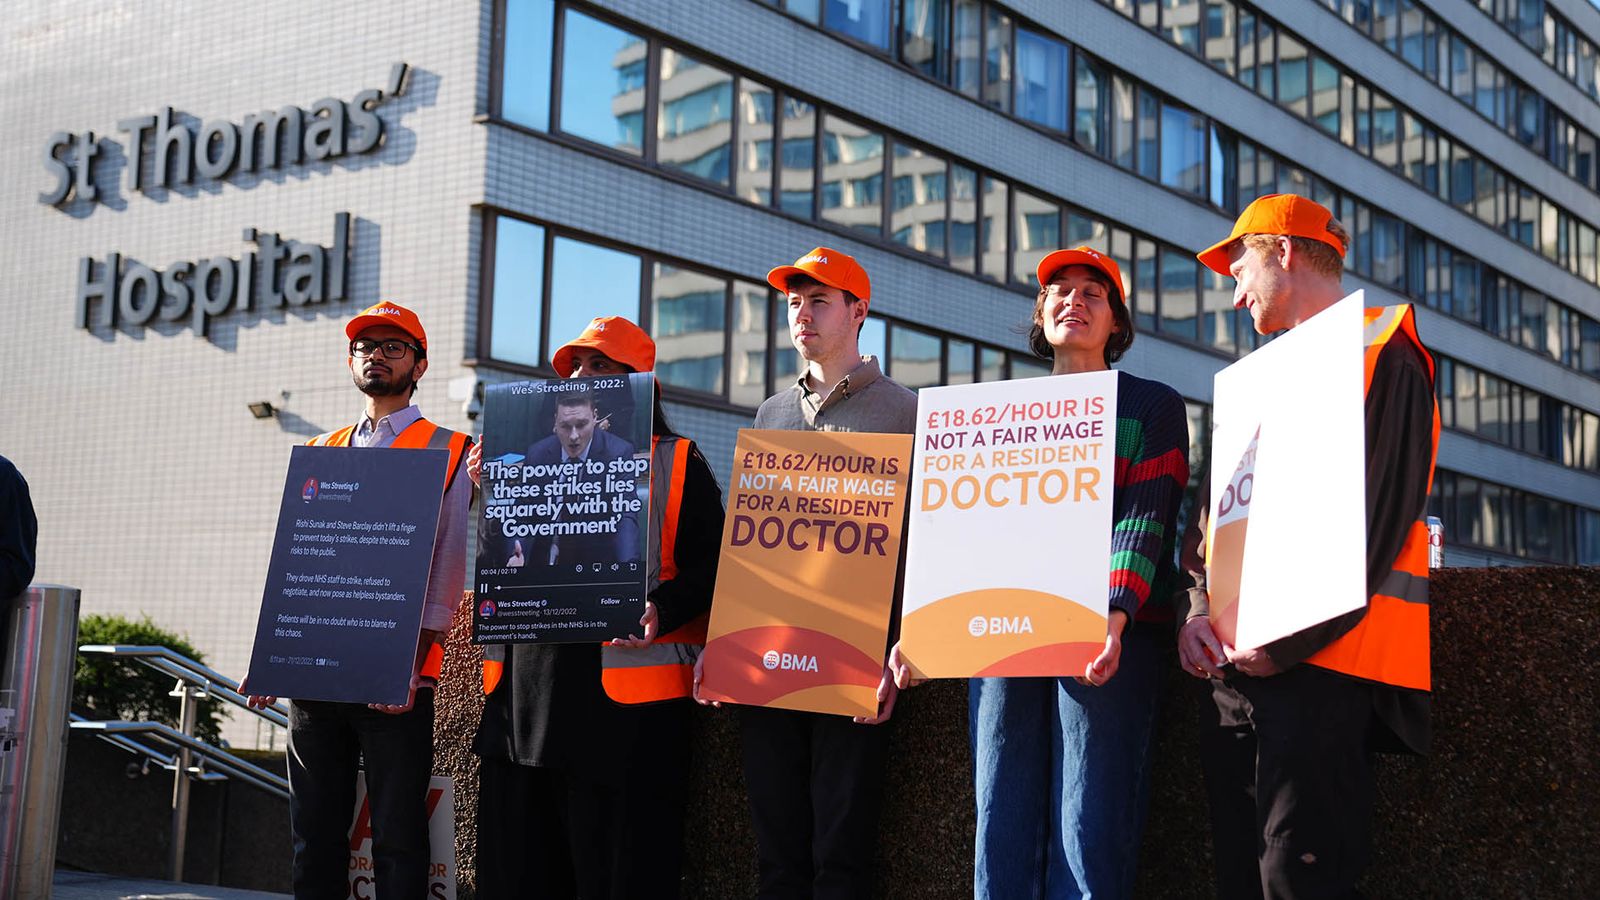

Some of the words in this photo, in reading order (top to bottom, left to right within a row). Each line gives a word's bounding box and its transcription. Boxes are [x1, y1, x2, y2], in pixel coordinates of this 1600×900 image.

[39, 131, 98, 206] St
[118, 63, 412, 191] Thomas'
[75, 212, 351, 337] Hospital
[511, 386, 533, 395] Wes
[536, 381, 590, 393] Streeting,
[593, 379, 625, 389] 2022:
[927, 399, 1076, 429] £18.62/HOUR
[1084, 396, 1105, 416] IS
[925, 432, 967, 451] NOT
[972, 431, 986, 448] A
[992, 426, 1037, 446] FAIR
[1042, 420, 1104, 441] WAGE
[742, 452, 876, 474] £18.62/HOUR
[880, 457, 900, 475] IS
[923, 453, 965, 473] FOR
[971, 451, 986, 470] A
[991, 443, 1103, 467] RESIDENT
[522, 462, 583, 483] power
[585, 458, 605, 475] to
[608, 456, 649, 477] stop
[331, 481, 353, 492] Streeting
[493, 483, 540, 499] these
[543, 476, 602, 496] strikes
[605, 475, 635, 493] lies
[737, 473, 777, 491] NOT
[779, 474, 793, 492] A
[797, 475, 837, 494] FAIR
[841, 478, 897, 497] WAGE
[920, 466, 1101, 512] DOCTOR
[485, 497, 562, 523] squarely
[565, 495, 608, 515] with
[611, 494, 642, 512] the
[736, 493, 774, 511] FOR
[777, 496, 791, 513] A
[795, 497, 894, 518] RESIDENT
[326, 520, 337, 529] and
[352, 521, 372, 533] Barclay
[400, 522, 416, 534] finger
[730, 514, 890, 557] DOCTOR
[299, 534, 320, 543] prevent
[359, 534, 379, 546] despite
[379, 536, 389, 545] the
[389, 536, 410, 546] obvious
[310, 547, 319, 556] the
[286, 572, 299, 584] They
[299, 573, 315, 583] drove
[314, 574, 328, 584] NHS
[327, 574, 341, 585] staff
[363, 576, 385, 587] refused
[308, 588, 321, 597] and
[320, 590, 332, 598] now
[331, 590, 346, 600] pose
[352, 589, 375, 601] helpless
[511, 600, 541, 609] Streeting
[600, 597, 621, 605] Follow
[277, 613, 300, 624] Patients
[299, 614, 309, 624] will
[329, 616, 347, 626] doubt
[346, 617, 359, 627] who
[370, 618, 388, 629] blame
[387, 619, 397, 629] for
[478, 623, 490, 631] The
[490, 624, 509, 632] power
[516, 623, 531, 631] stop
[530, 621, 551, 630] strikes
[557, 621, 569, 629] the
[568, 620, 584, 628] NHS
[596, 619, 608, 628] the
[989, 617, 1033, 635] BMA
[274, 627, 285, 637] this
[517, 632, 538, 640] hands.
[781, 653, 819, 673] BMA
